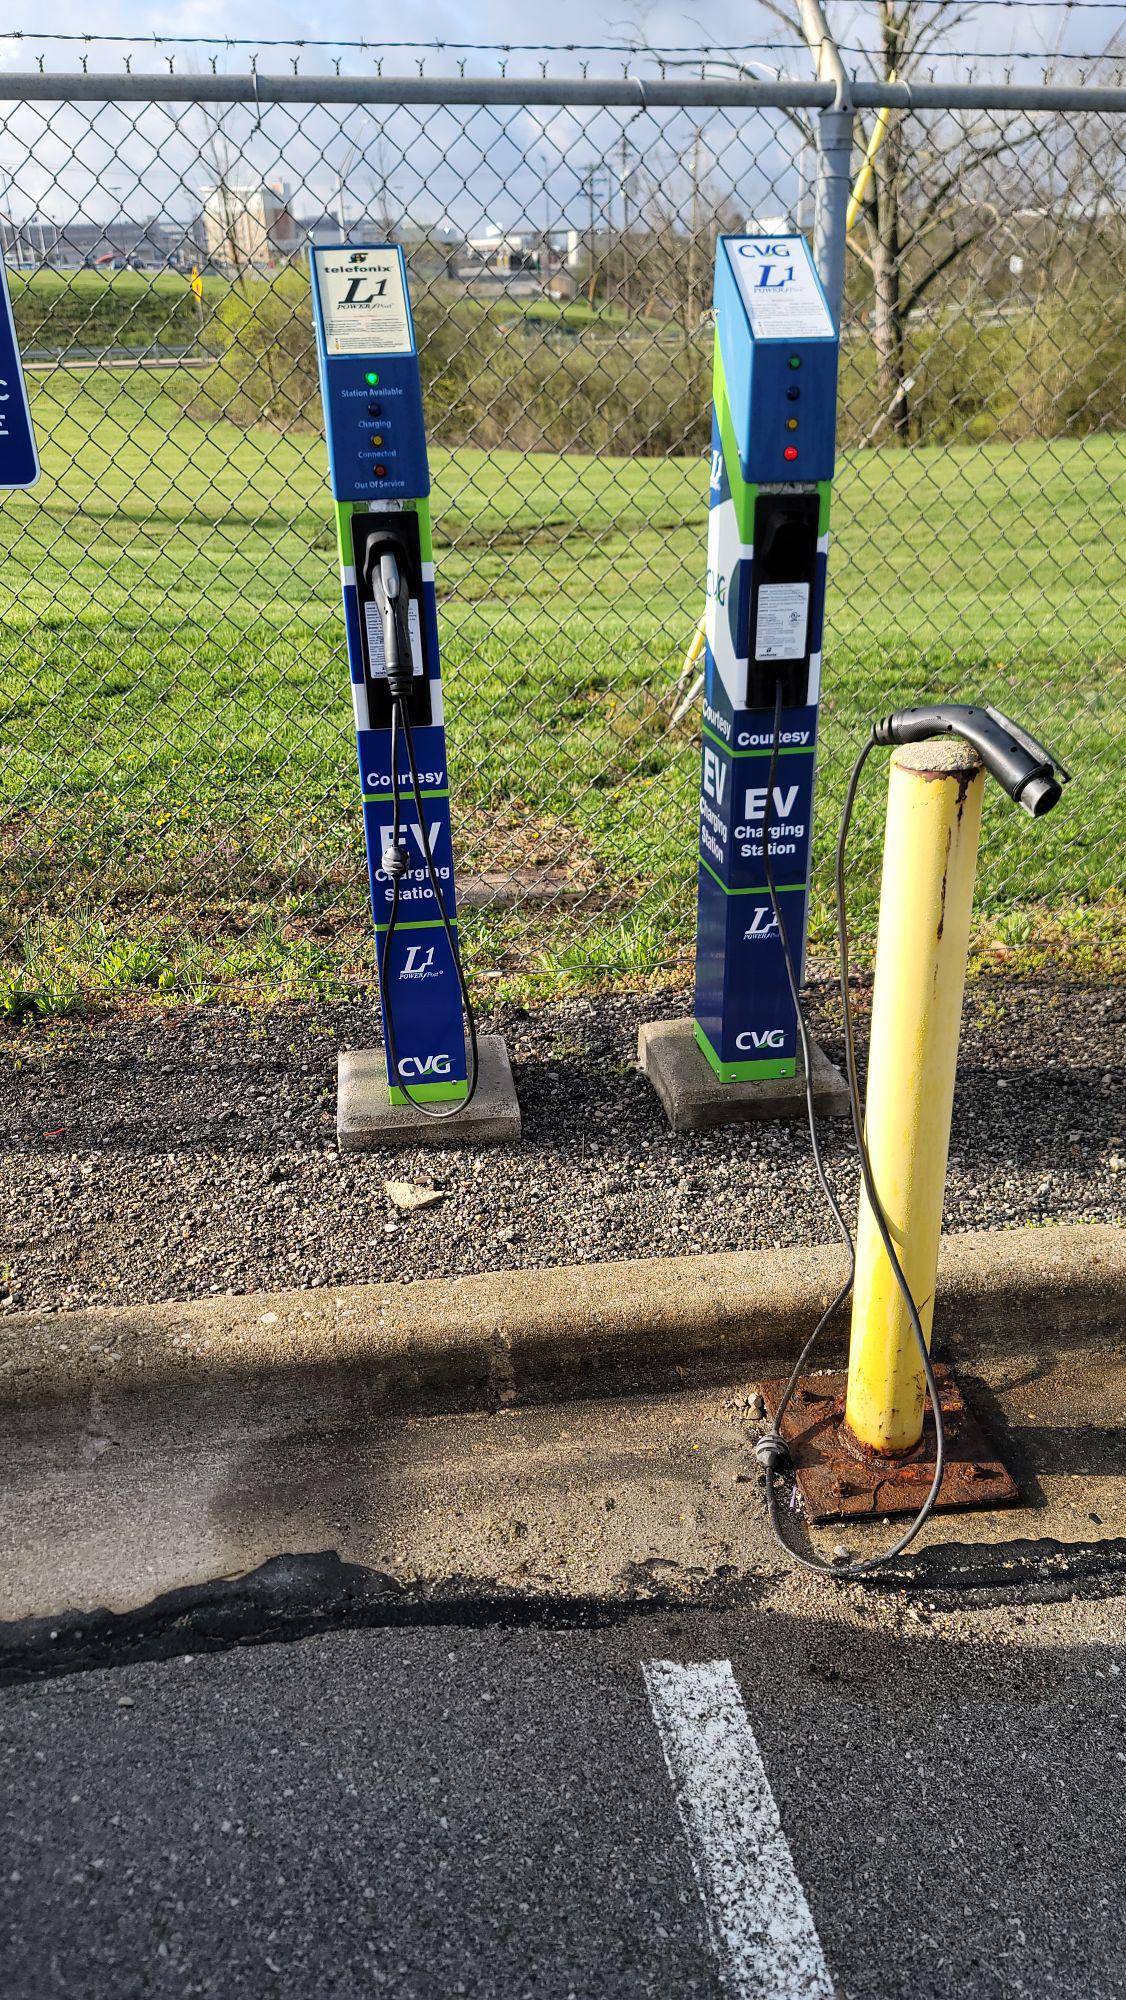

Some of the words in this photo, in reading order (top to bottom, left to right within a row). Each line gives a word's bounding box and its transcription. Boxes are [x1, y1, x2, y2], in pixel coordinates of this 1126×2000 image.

[738, 244, 790, 258] CVG
[324, 265, 391, 274] telefonix
[338, 277, 388, 305] L1
[341, 389, 368, 398] Station
[369, 387, 403, 397] Available
[358, 420, 392, 429] Charging
[358, 449, 397, 459] Connected
[354, 481, 368, 489] Out
[369, 480, 378, 488] Of
[379, 479, 405, 488] Service
[703, 697, 731, 741] Courtesy
[704, 746, 726, 806] EV
[744, 785, 799, 820] EV
[700, 796, 728, 844] Charging
[701, 825, 724, 865] Station
[741, 842, 796, 857] Station
[400, 946, 434, 974] L1
[735, 1028, 786, 1051] CVG
[397, 1053, 452, 1078] CVG
